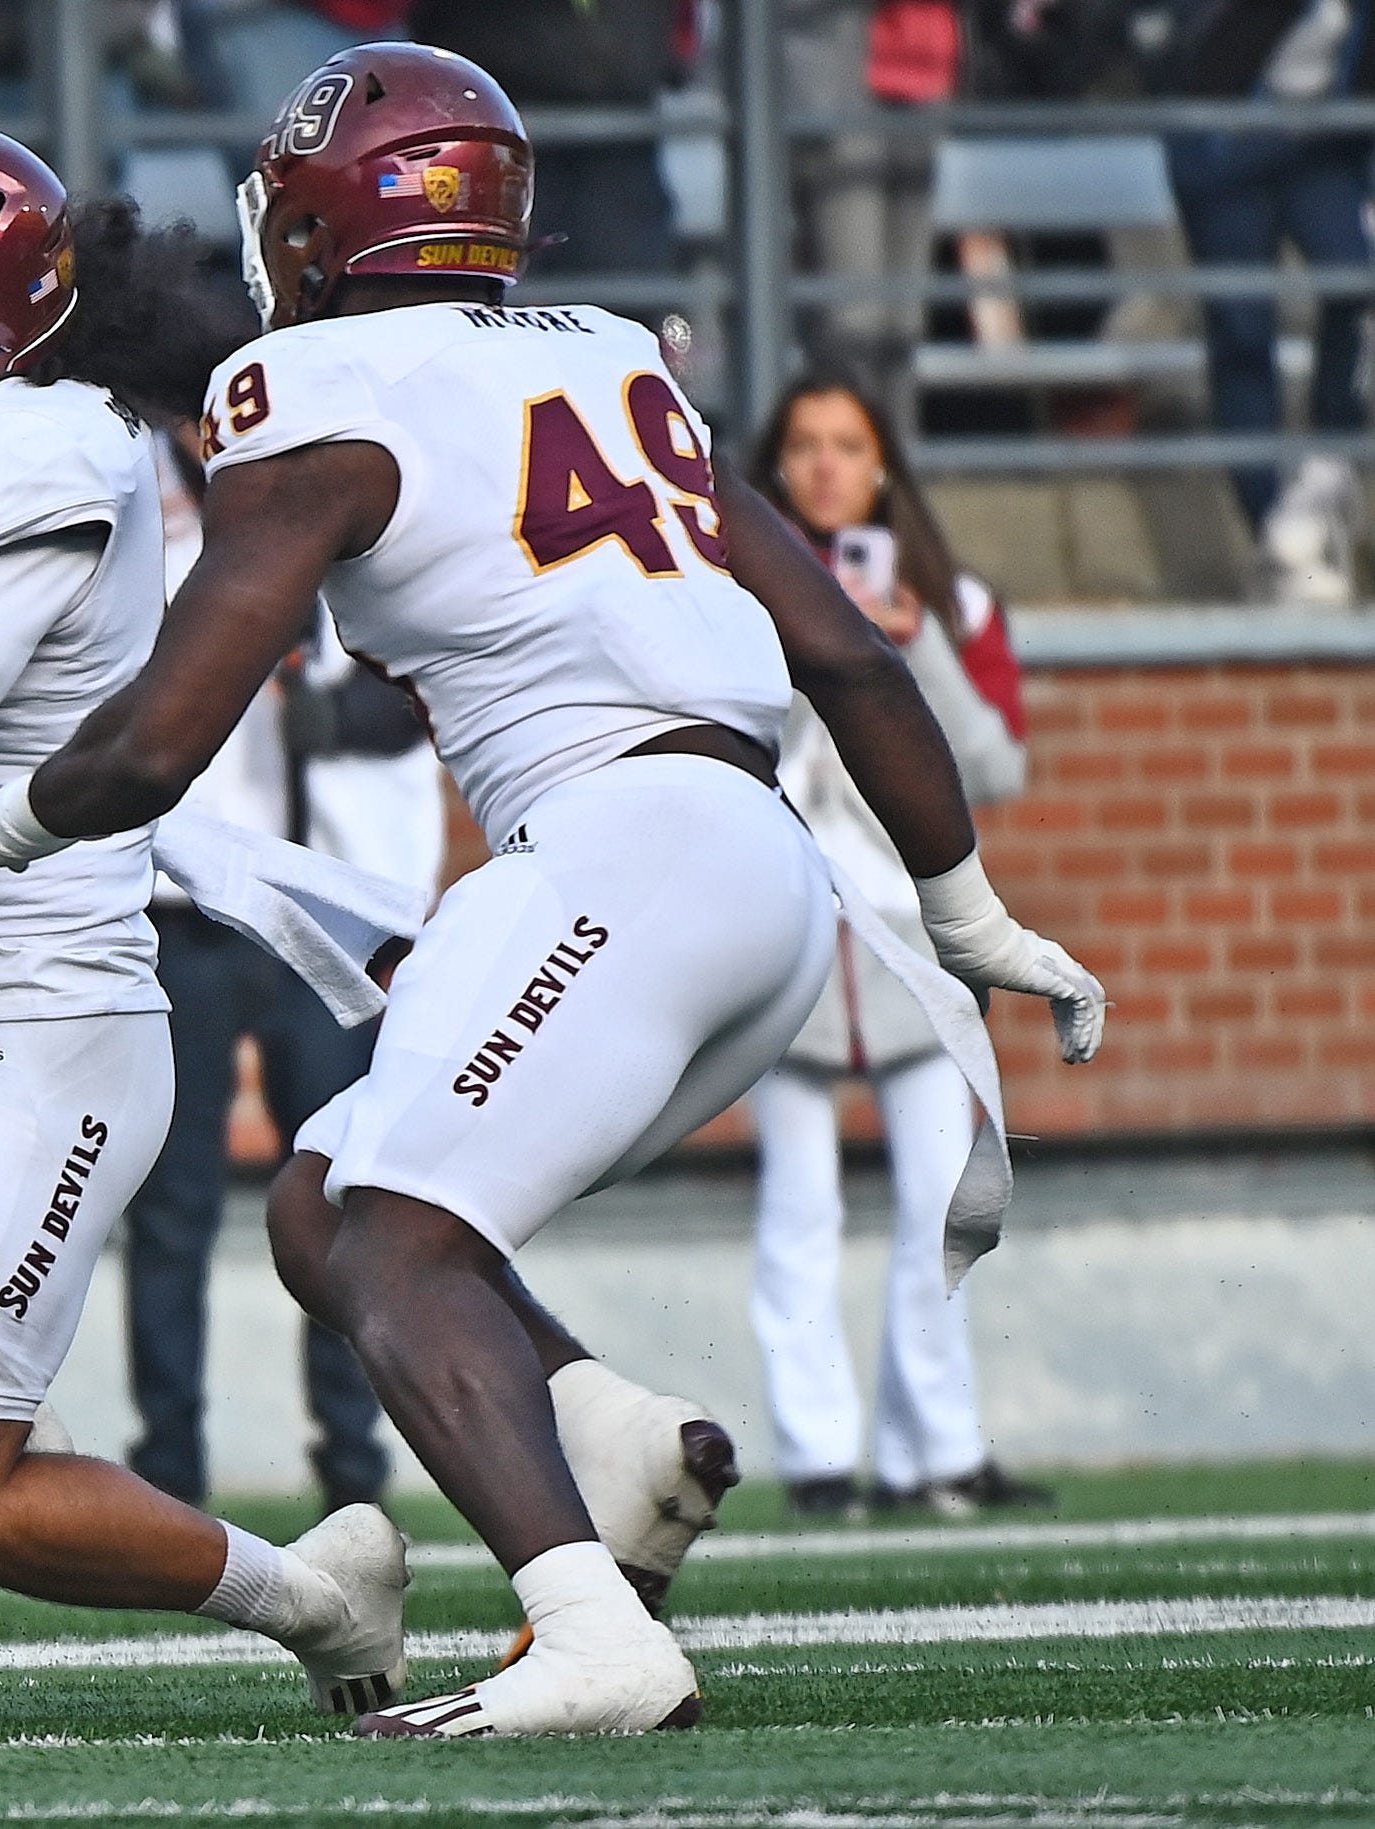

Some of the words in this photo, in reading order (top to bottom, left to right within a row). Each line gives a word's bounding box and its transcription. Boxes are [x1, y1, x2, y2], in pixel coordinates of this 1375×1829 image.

[417, 244, 464, 266] SUN
[511, 369, 733, 579] 49
[453, 1029, 524, 1108] SUN
[507, 915, 609, 1035] DEVILS
[41, 1114, 109, 1243] DEVILS
